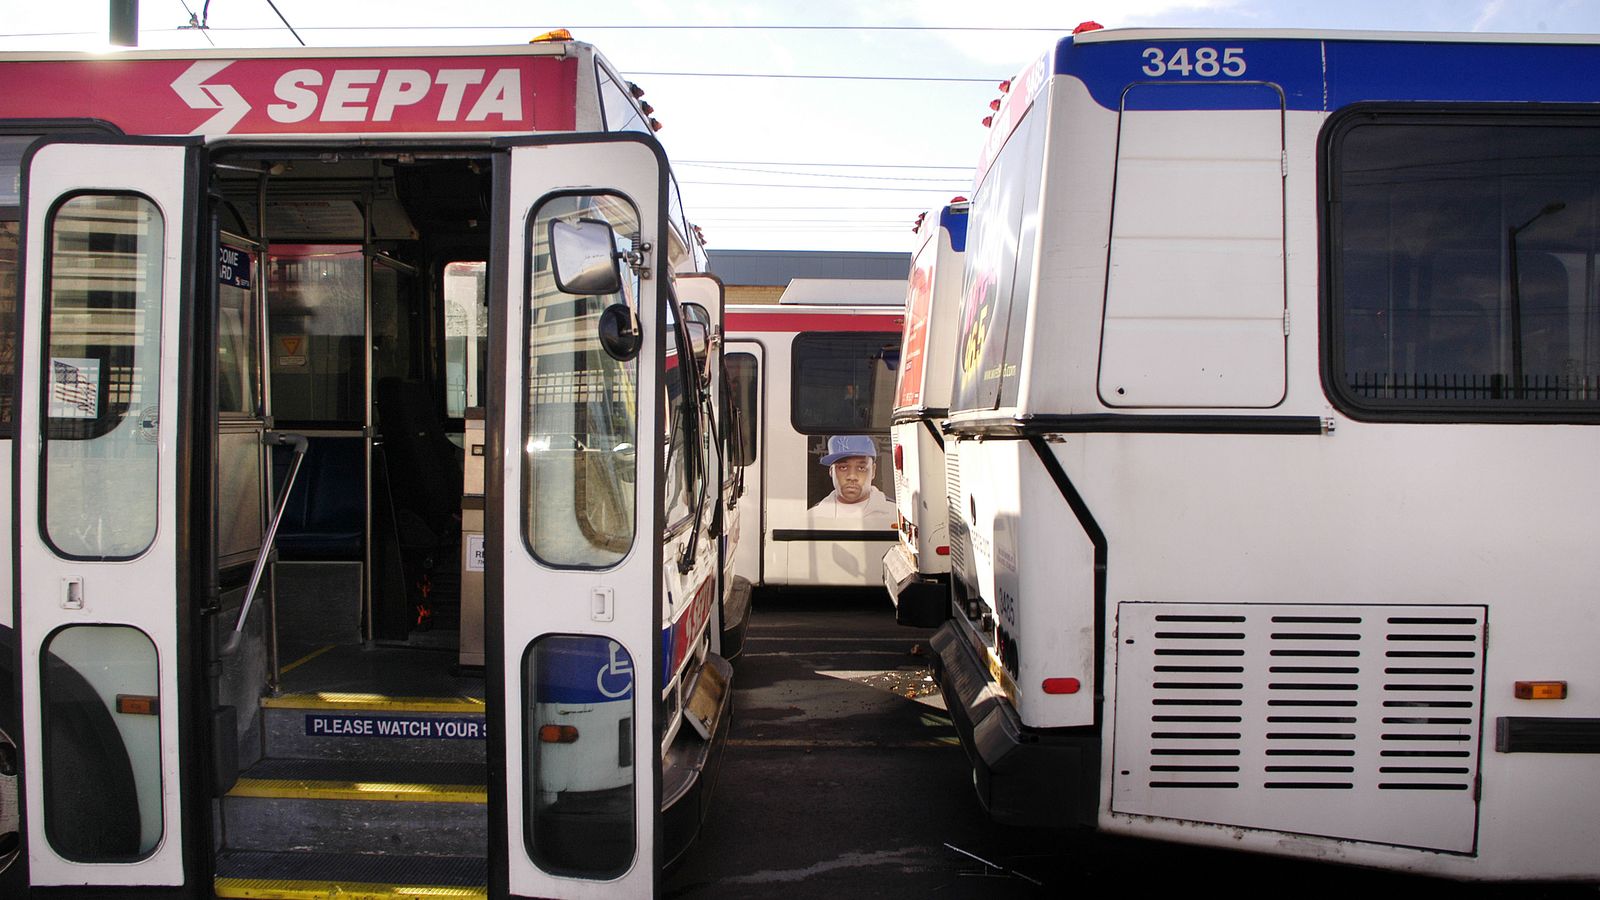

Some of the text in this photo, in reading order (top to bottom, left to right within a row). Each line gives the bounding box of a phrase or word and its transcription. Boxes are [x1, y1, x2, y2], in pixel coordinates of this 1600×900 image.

[1142, 47, 1247, 78] 3485
[267, 68, 523, 122] SEPTA
[314, 719, 373, 735] PLEASE
[378, 721, 431, 736] WATCH
[435, 722, 479, 737] YOUR
